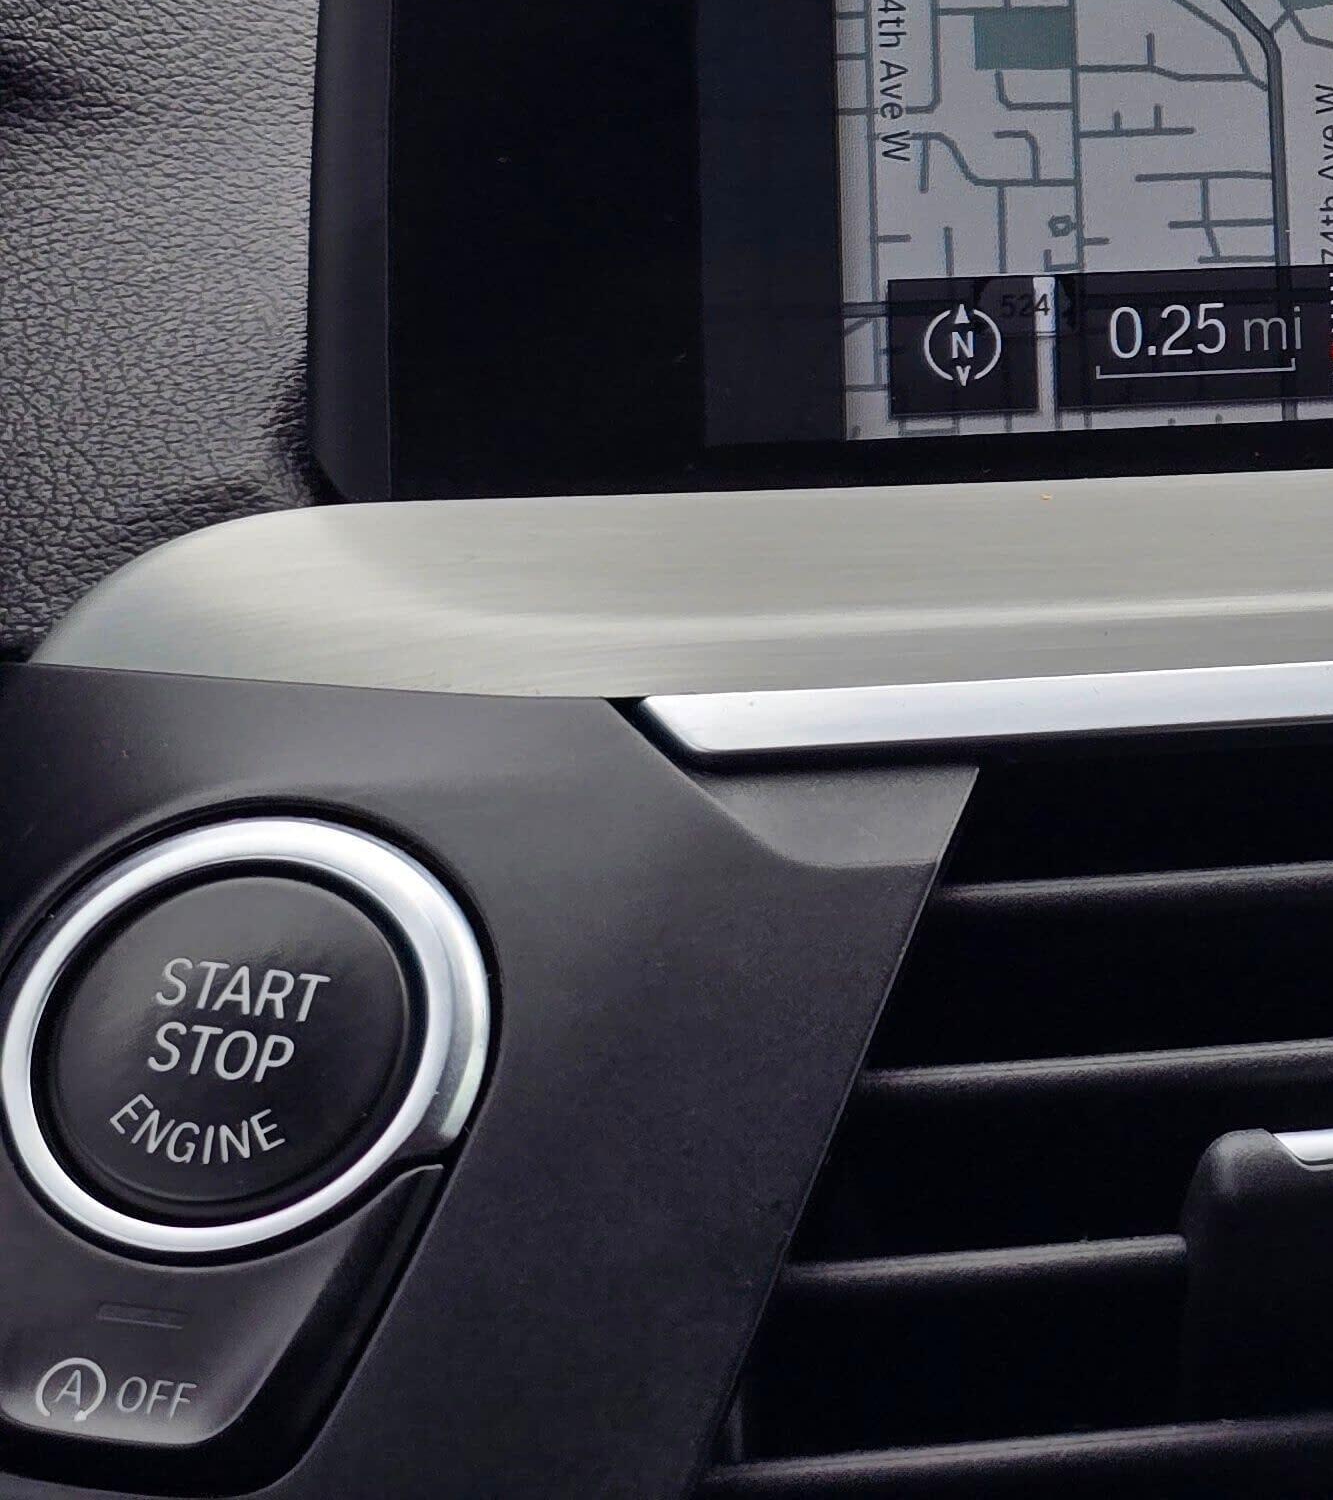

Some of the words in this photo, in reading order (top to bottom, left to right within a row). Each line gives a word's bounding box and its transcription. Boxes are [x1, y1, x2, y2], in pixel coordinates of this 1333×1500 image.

[880, 59, 909, 120] Ave
[881, 130, 911, 161] W
[1110, 302, 1226, 359] 0.25
[1244, 305, 1301, 351] mi
[156, 957, 331, 1022] START
[148, 1021, 295, 1083] STOP
[109, 1093, 286, 1165] ENGINE
[116, 1376, 198, 1421] OFF
